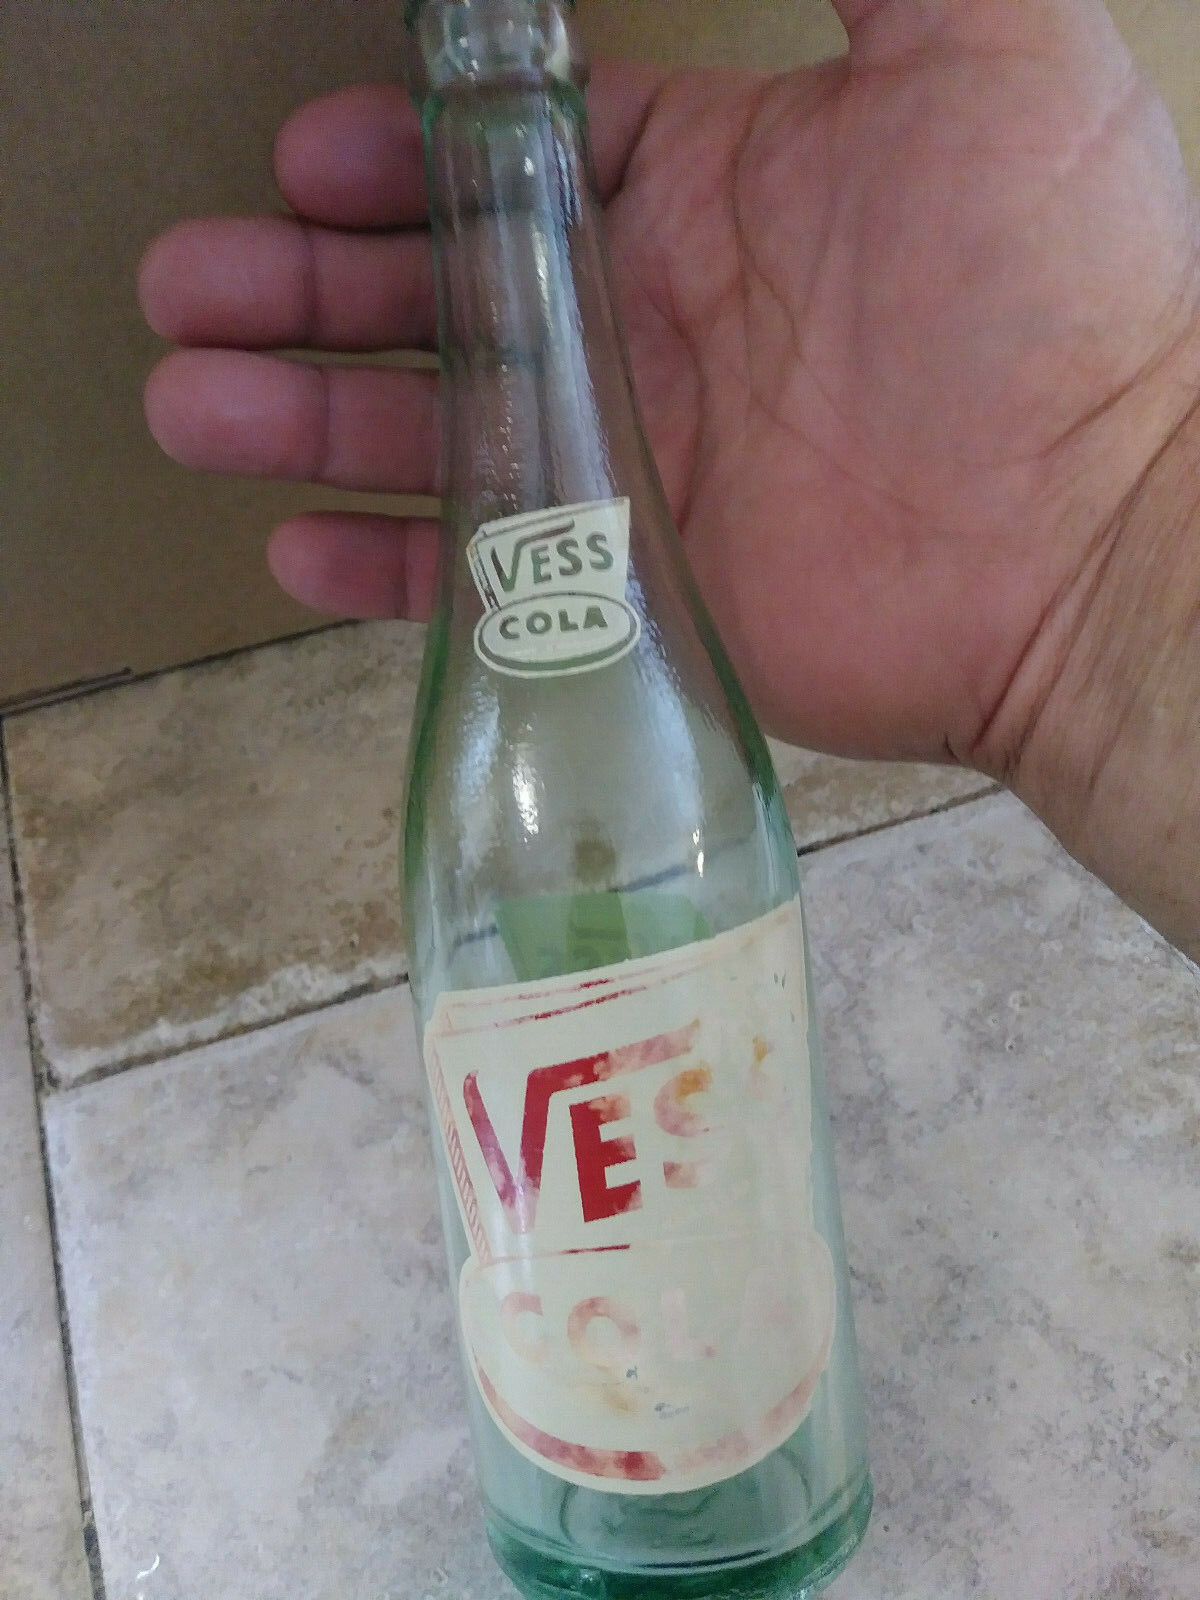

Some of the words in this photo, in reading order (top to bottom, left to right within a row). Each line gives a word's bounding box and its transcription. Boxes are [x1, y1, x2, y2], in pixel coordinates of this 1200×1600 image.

[490, 518, 614, 592] VESS
[500, 605, 608, 640] COLA
[463, 1019, 772, 1235] VES
